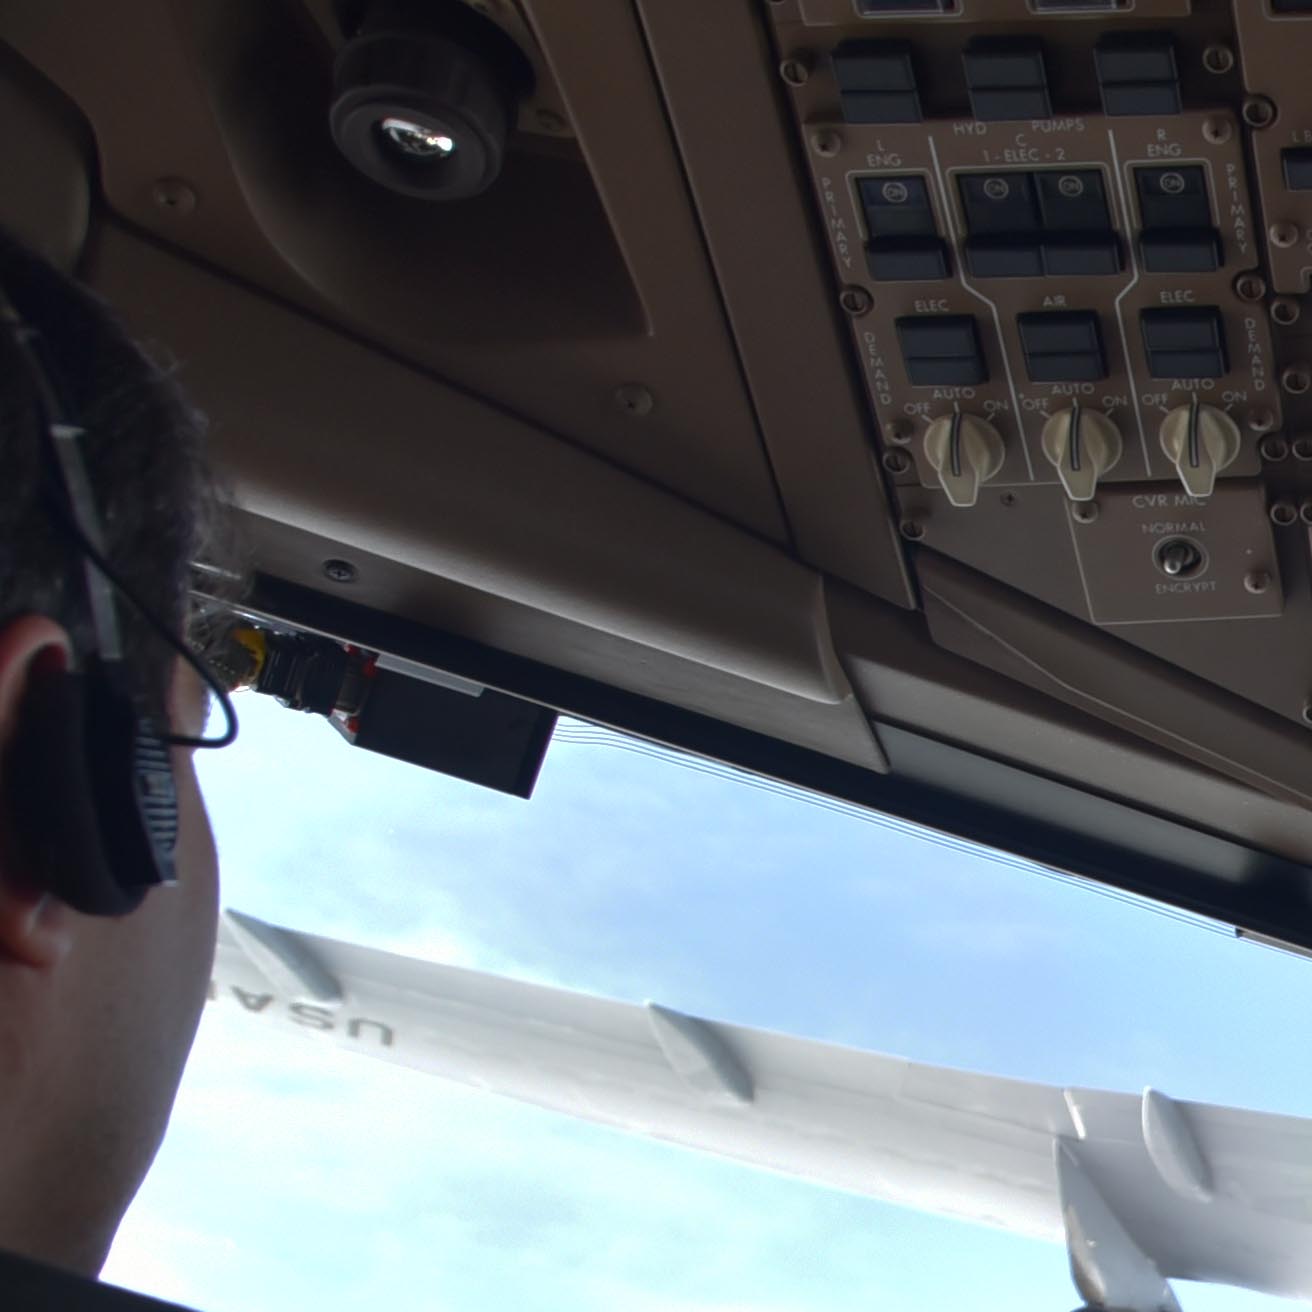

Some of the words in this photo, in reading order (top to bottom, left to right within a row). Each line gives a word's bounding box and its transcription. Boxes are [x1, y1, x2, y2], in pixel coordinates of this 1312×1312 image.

[952, 122, 989, 136] HYD
[1032, 120, 1085, 134] PUMPS
[1147, 144, 1182, 158] ENG
[867, 153, 902, 168] ENG
[1043, 295, 1066, 307] AIR
[1160, 289, 1195, 303] ELEC
[915, 299, 947, 313] ELEC
[1051, 382, 1094, 396] AUTO
[1171, 378, 1214, 392] AUTO
[932, 387, 975, 401] AUTO
[1132, 495, 1170, 509] CVR
[1175, 494, 1207, 507] MIC
[1141, 521, 1207, 534] NORMAL
[208, 978, 396, 1047] USA
